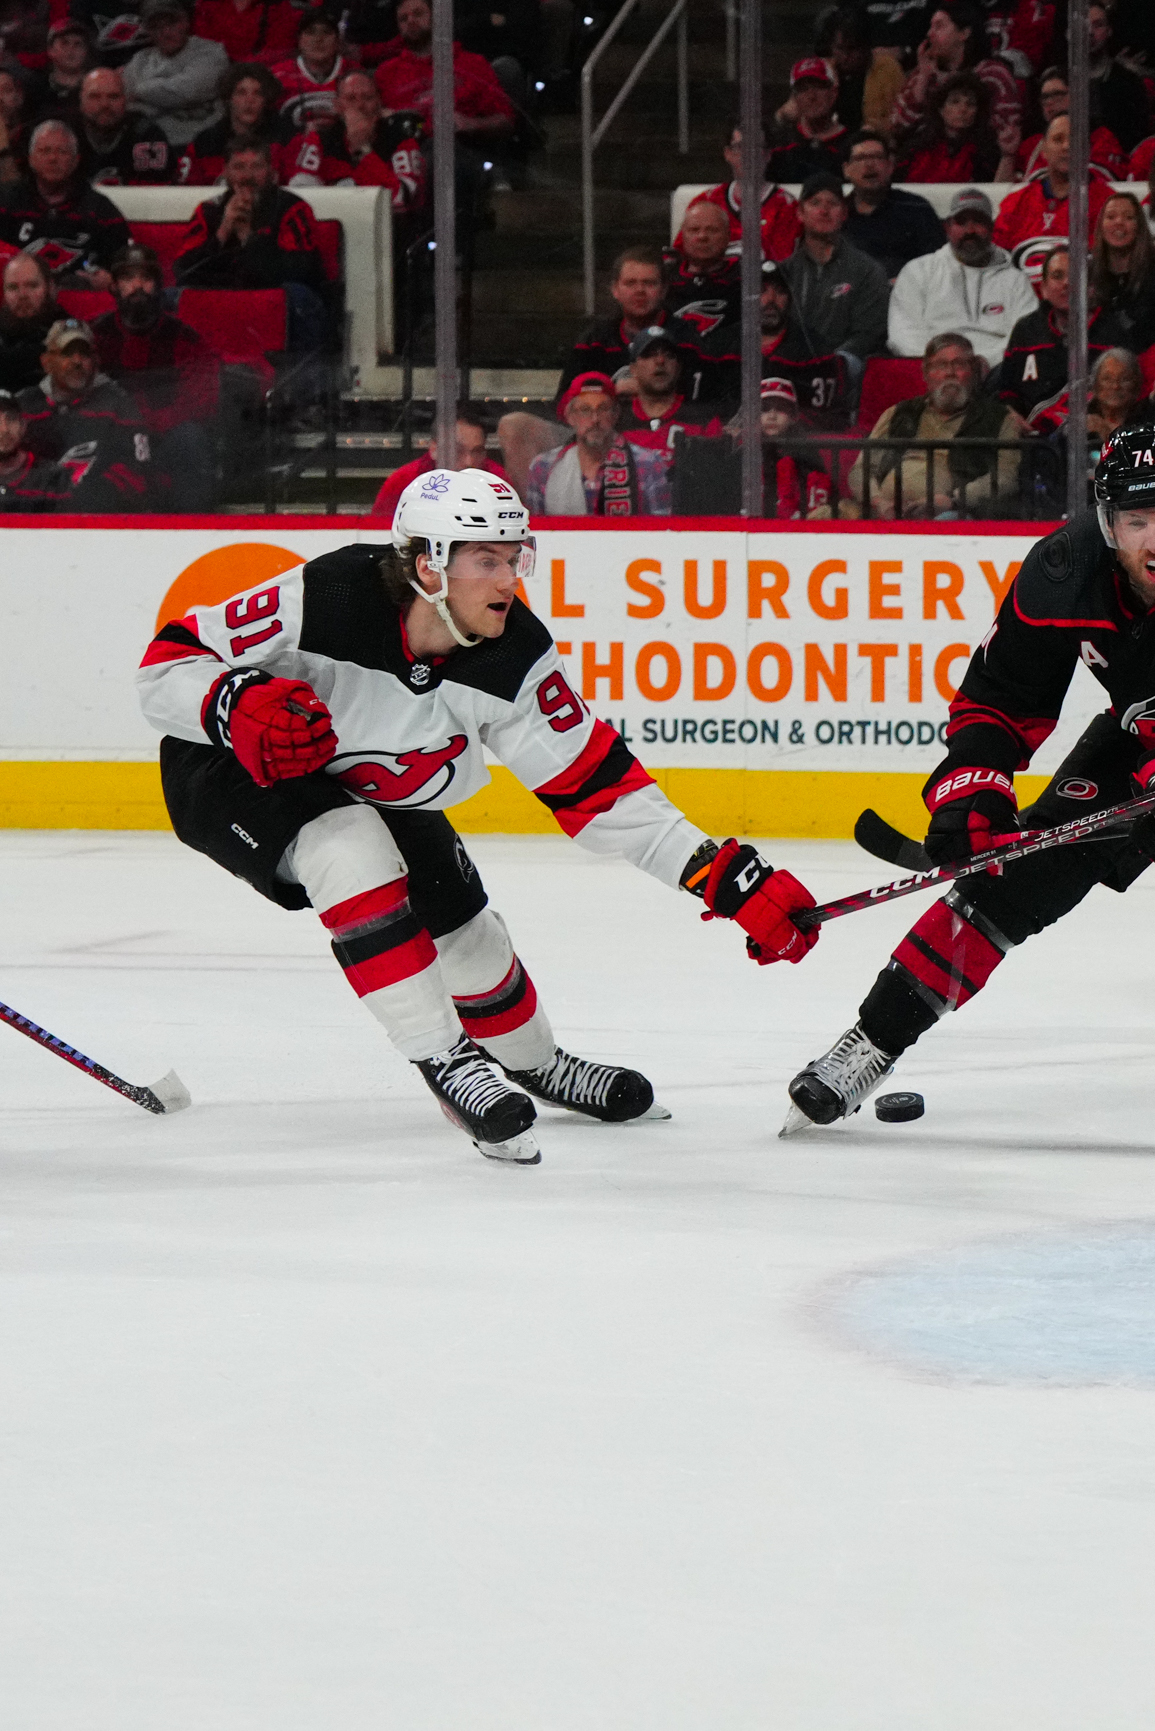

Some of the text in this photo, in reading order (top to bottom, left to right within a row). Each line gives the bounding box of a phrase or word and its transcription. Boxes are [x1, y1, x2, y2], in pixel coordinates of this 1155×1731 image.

[811, 377, 836, 407] 37
[1132, 449, 1155, 468] 74
[497, 511, 525, 519] CCM
[625, 558, 1022, 620] SURGERY
[225, 585, 283, 658] 91
[1080, 640, 1109, 668] A
[536, 669, 591, 733] 9
[642, 718, 779, 745] SURGEON
[788, 719, 806, 745] &
[231, 822, 259, 849] CCM
[1034, 810, 1108, 842] JETSPEED
[954, 825, 1094, 879] JETSPEED
[870, 866, 941, 899] CCM
